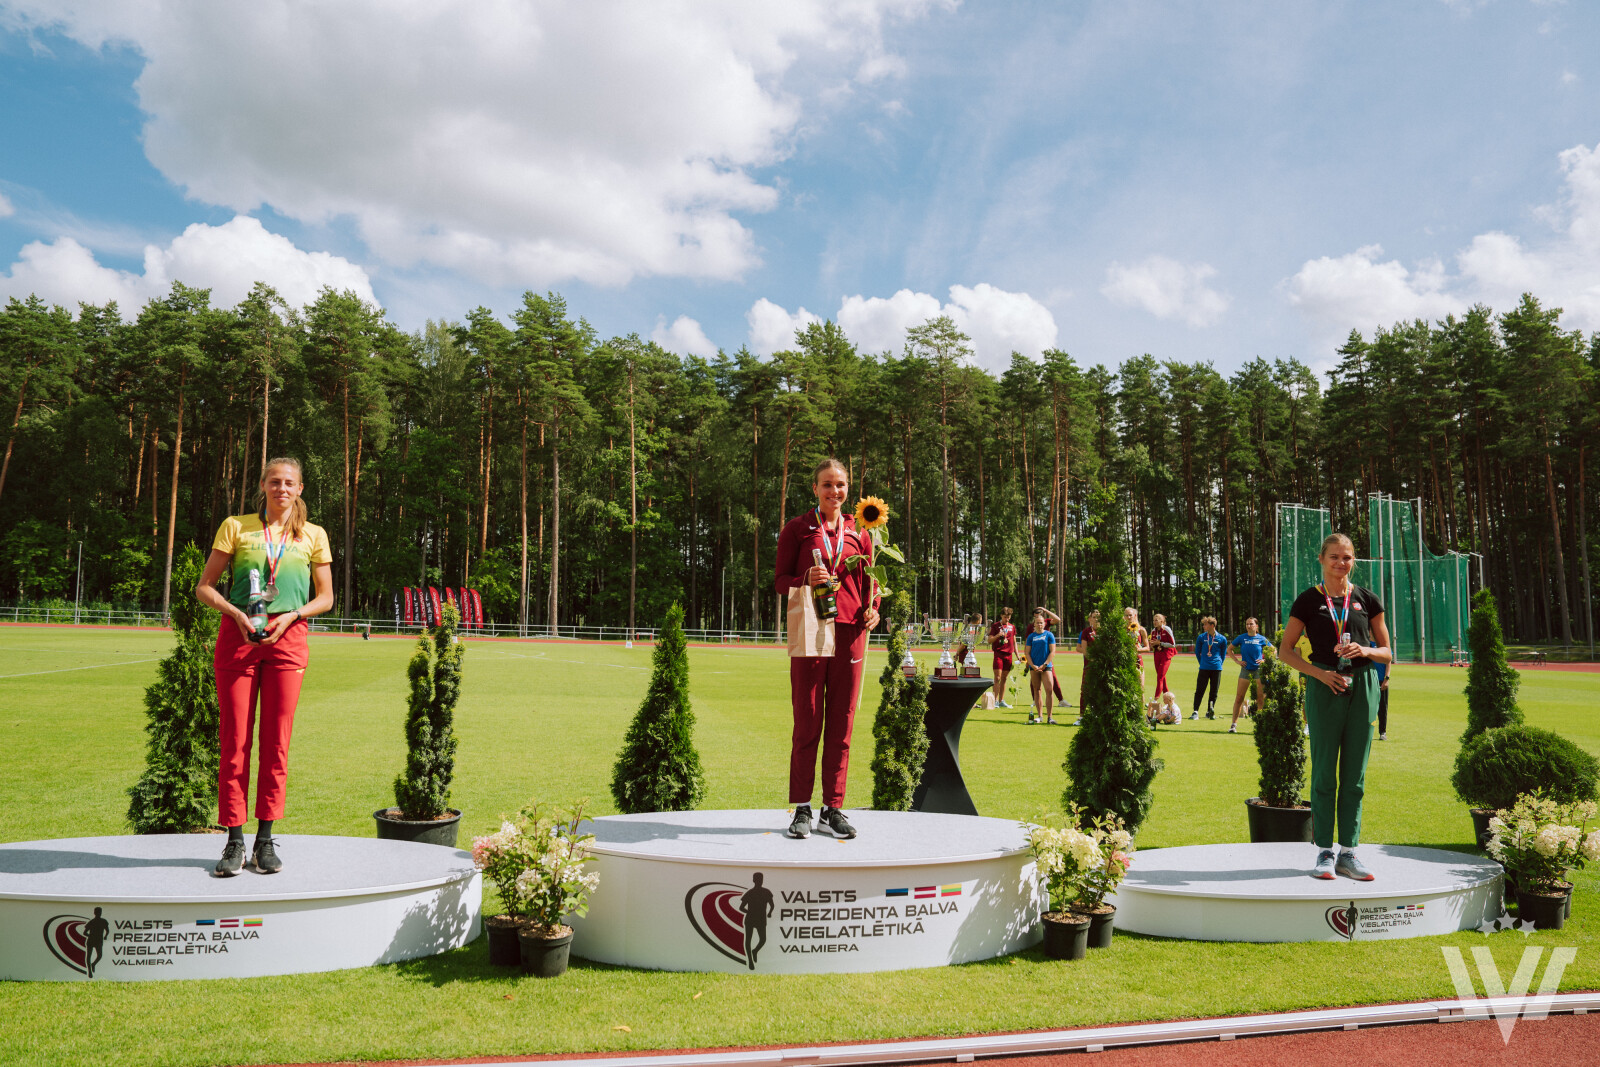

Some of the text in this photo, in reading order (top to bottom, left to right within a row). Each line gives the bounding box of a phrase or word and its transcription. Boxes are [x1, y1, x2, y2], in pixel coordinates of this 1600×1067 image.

[251, 543, 298, 553] LIEVA
[780, 890, 857, 904] VALSTS
[780, 901, 959, 922] PREZIDENTA BALVA
[1360, 913, 1402, 921] PREZIDENTA
[114, 920, 173, 930] VALSTS
[779, 918, 925, 939] VIEGLATLĒTIKĀ
[113, 930, 260, 943] PREZIDENTA BALVA
[112, 941, 229, 956] VIEGLATLĒTIKĀ
[779, 943, 859, 953] VALMIERA
[111, 958, 174, 966] VALMIERA
